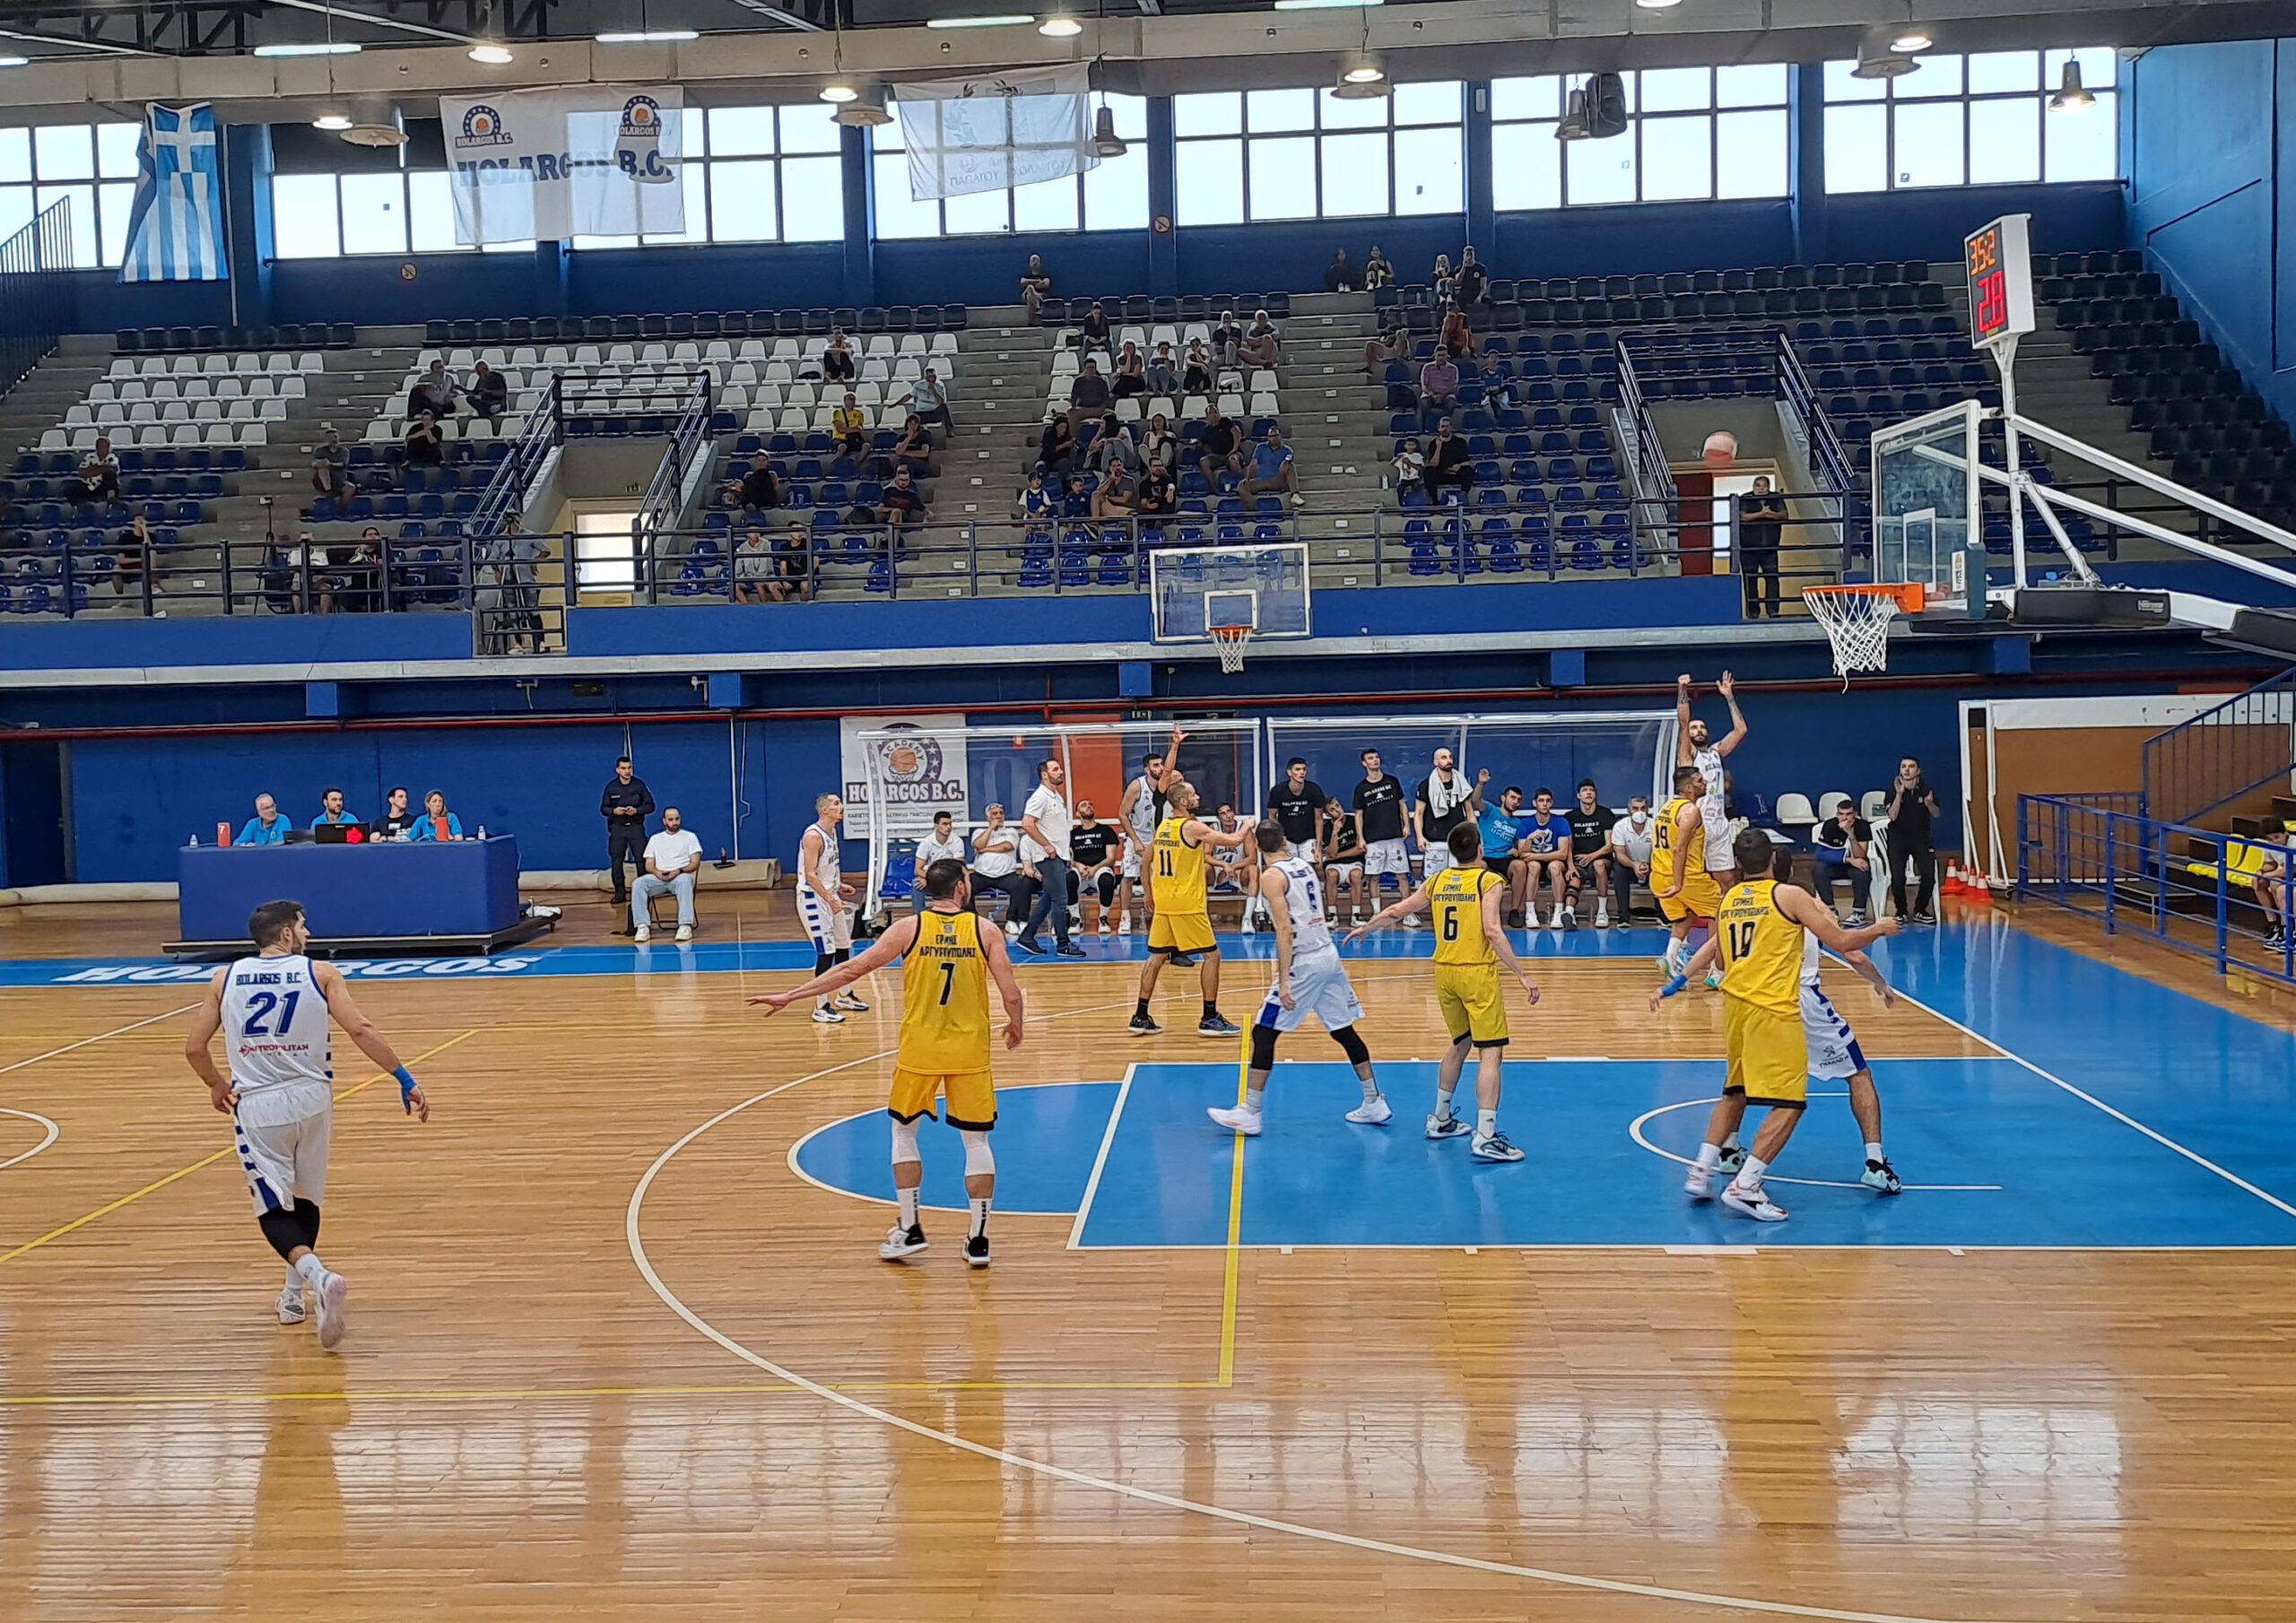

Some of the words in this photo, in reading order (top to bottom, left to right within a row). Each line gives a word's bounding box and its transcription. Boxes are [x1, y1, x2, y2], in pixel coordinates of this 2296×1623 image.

[457, 151, 612, 187] HOLARGOS
[618, 149, 672, 177] B.C.
[883, 738, 925, 761] ACADEMY
[931, 781, 963, 801] B.C.
[1159, 848, 1174, 877] 11
[1443, 906, 1458, 942] 6
[1728, 921, 1756, 962] 10
[939, 962, 956, 1006] 7
[241, 990, 300, 1037] 21
